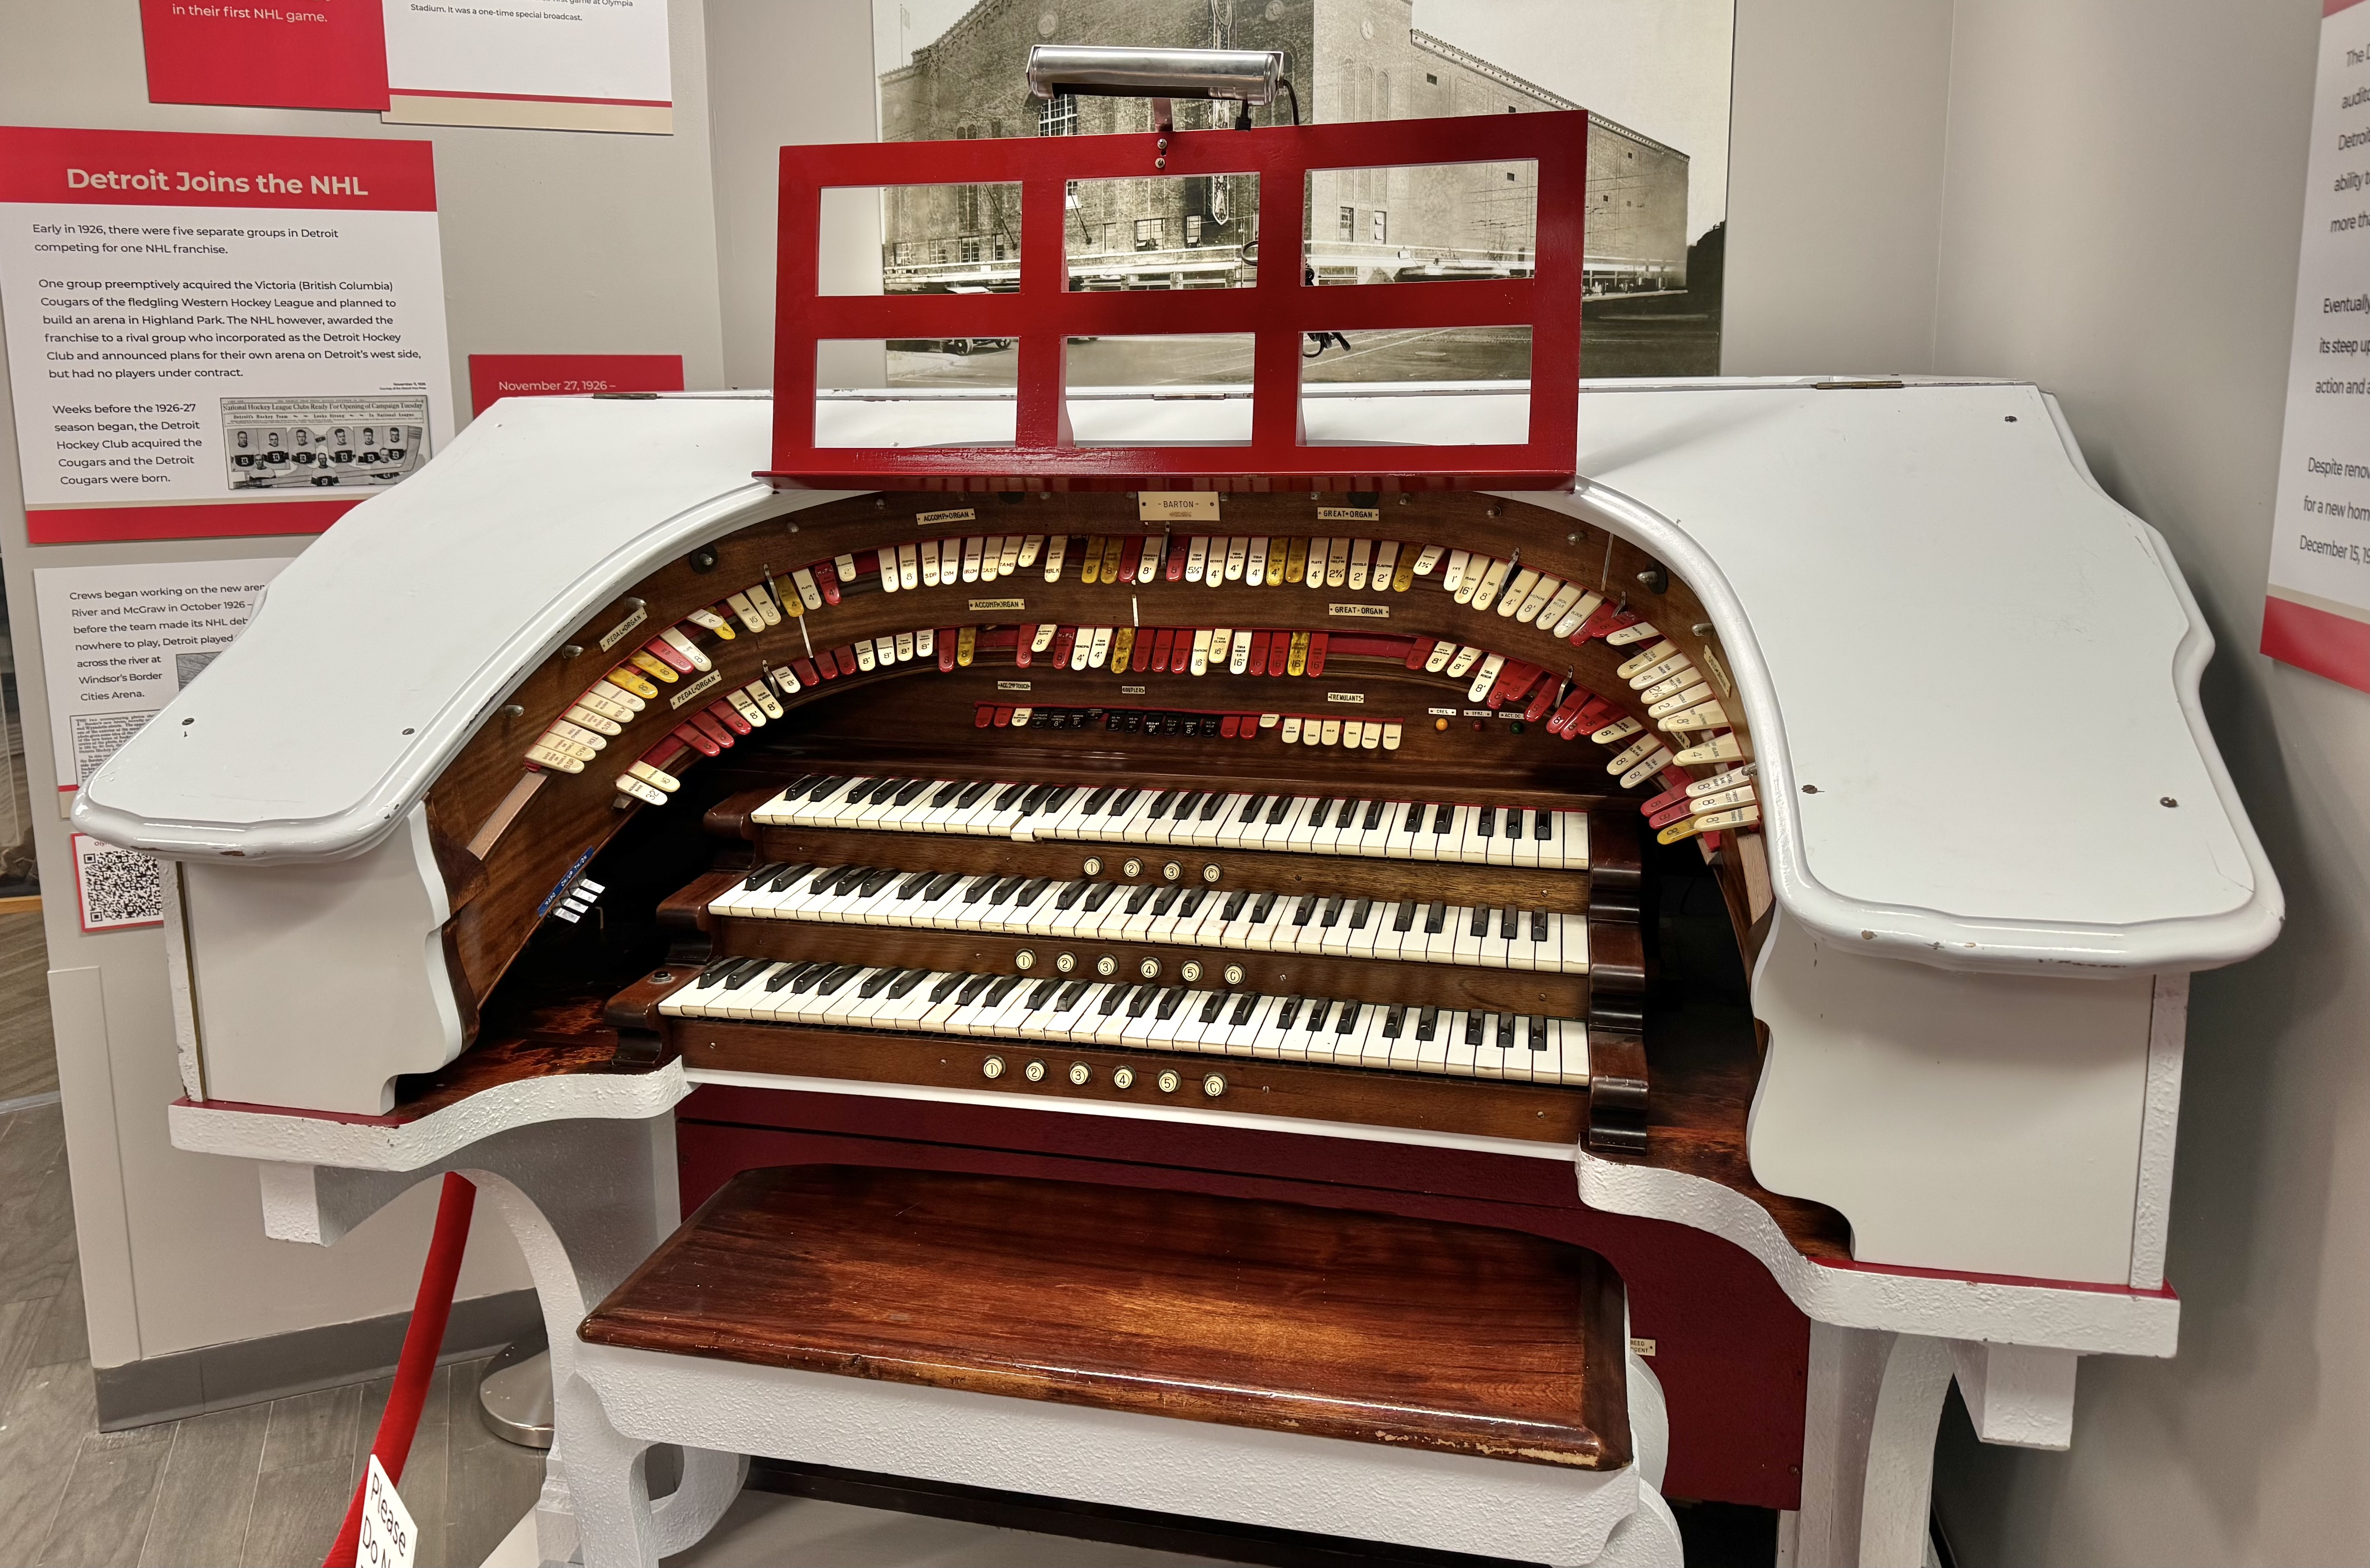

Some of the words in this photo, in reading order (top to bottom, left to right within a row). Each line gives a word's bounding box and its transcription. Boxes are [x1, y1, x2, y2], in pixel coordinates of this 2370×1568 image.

[172, 3, 186, 15] in
[188, 4, 221, 17] their
[223, 6, 251, 19] first
[254, 8, 284, 20] NHL
[286, 12, 328, 23] game.
[411, 3, 446, 13] Stadium.
[478, 9, 514, 17] one-time
[543, 12, 583, 21] broadcast.
[2347, 49, 2364, 67] The
[67, 168, 170, 191] Detroit
[176, 170, 250, 192] Joins
[255, 173, 303, 194] the
[310, 175, 368, 196] NHL
[2334, 172, 2363, 191] ability
[33, 224, 62, 235] Early
[64, 224, 75, 234] in
[77, 225, 106, 235] 1926,
[108, 225, 140, 235] there
[172, 226, 194, 236] five
[196, 228, 244, 238] separate
[247, 230, 286, 239] groups
[288, 228, 298, 238] in
[301, 228, 339, 238] Detroit
[2331, 217, 2356, 232] more
[34, 242, 99, 254] competing
[101, 243, 118, 252] for
[145, 244, 172, 253] NHL
[172, 244, 228, 254] franchise.
[38, 279, 64, 288] One
[66, 281, 102, 290] group
[104, 279, 180, 291] preemptively
[183, 280, 231, 291] acquired
[234, 280, 253, 290] the
[254, 280, 296, 290] Victoria
[299, 281, 337, 292] (British
[339, 281, 393, 292] Columbia)
[2319, 337, 2330, 353] its
[2332, 339, 2358, 356] steep
[499, 381, 561, 391] November
[563, 381, 580, 392] 27,
[581, 381, 608, 391] 1926
[2316, 377, 2344, 394] action
[2346, 378, 2366, 394] and
[52, 404, 92, 414] Weeks
[94, 404, 131, 414] before
[133, 404, 153, 413] the
[154, 403, 196, 413] 1926-27
[97, 422, 137, 433] began,
[138, 421, 159, 430] the
[161, 420, 200, 430] Detroit
[56, 440, 100, 451] Hockey
[102, 439, 129, 449] Club
[131, 438, 181, 450] acquired
[183, 438, 202, 447] the
[58, 459, 107, 469] Cougars
[108, 456, 131, 466] and
[133, 456, 153, 465] the
[156, 455, 195, 465] Detroit
[2308, 457, 2343, 477] Despite
[60, 476, 109, 486] Cougars
[141, 474, 171, 482] born.
[2304, 496, 2316, 512] for
[2317, 502, 2323, 513] a
[2325, 502, 2346, 517] new
[2300, 535, 2348, 559] December
[607, 629, 623, 645] PEDAL
[624, 614, 642, 631] ORGAN
[109, 657, 127, 666] the
[128, 656, 150, 665] river
[78, 674, 128, 685] Windsor's
[129, 672, 163, 681] Border
[80, 692, 110, 701] Cities
[111, 691, 146, 699] Arena.
[677, 688, 696, 703] PEDAL
[696, 675, 716, 690] ORGAN
[1128, 864, 1134, 874] 2
[1169, 868, 1174, 877] 3
[1062, 960, 1067, 969] 2
[1103, 962, 1108, 971] 3
[1145, 965, 1152, 975] 4
[1187, 969, 1193, 978] 5
[1031, 1068, 1037, 1078] 2
[1075, 1071, 1082, 1080] 3
[1119, 1075, 1126, 1085] 4
[1164, 1079, 1170, 1089] 5
[371, 1472, 406, 1557] Please
[363, 1515, 378, 1564] Do
